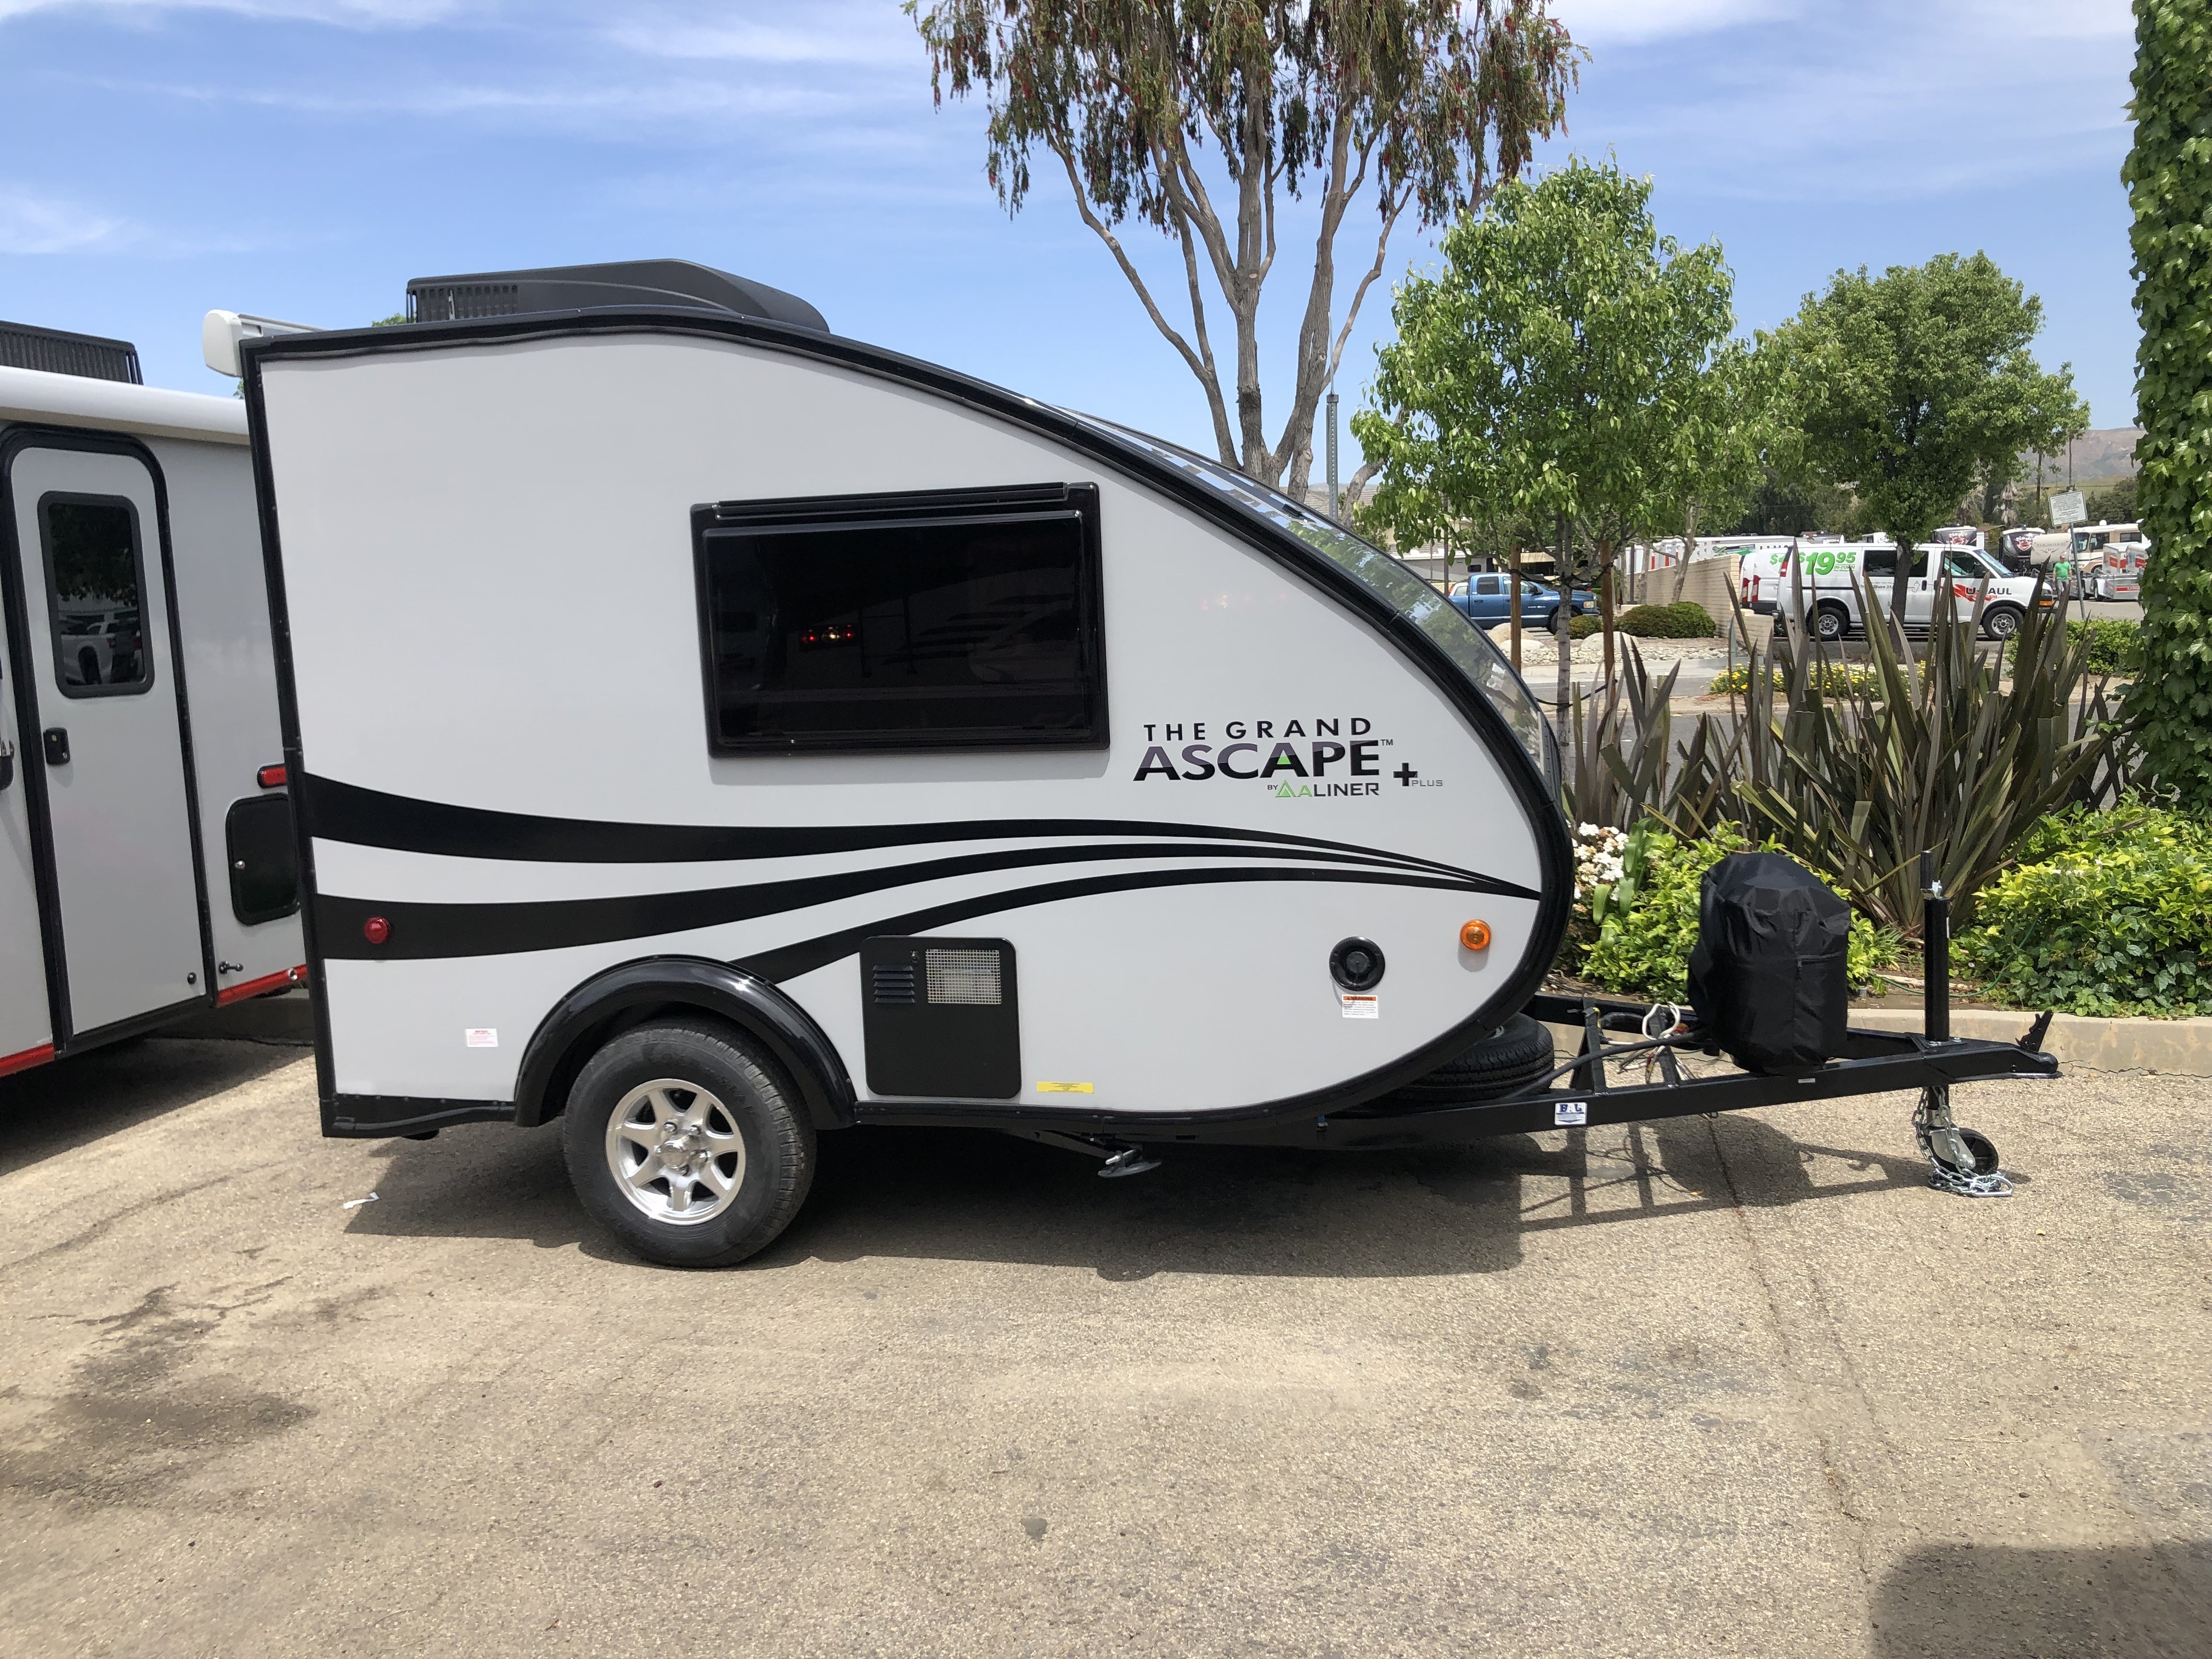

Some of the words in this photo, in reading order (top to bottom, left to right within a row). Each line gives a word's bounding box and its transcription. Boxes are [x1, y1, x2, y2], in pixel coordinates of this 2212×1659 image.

[1143, 723, 1206, 742] THE
[1225, 717, 1371, 740] GRAND
[1132, 740, 1380, 782] ASCAPE
